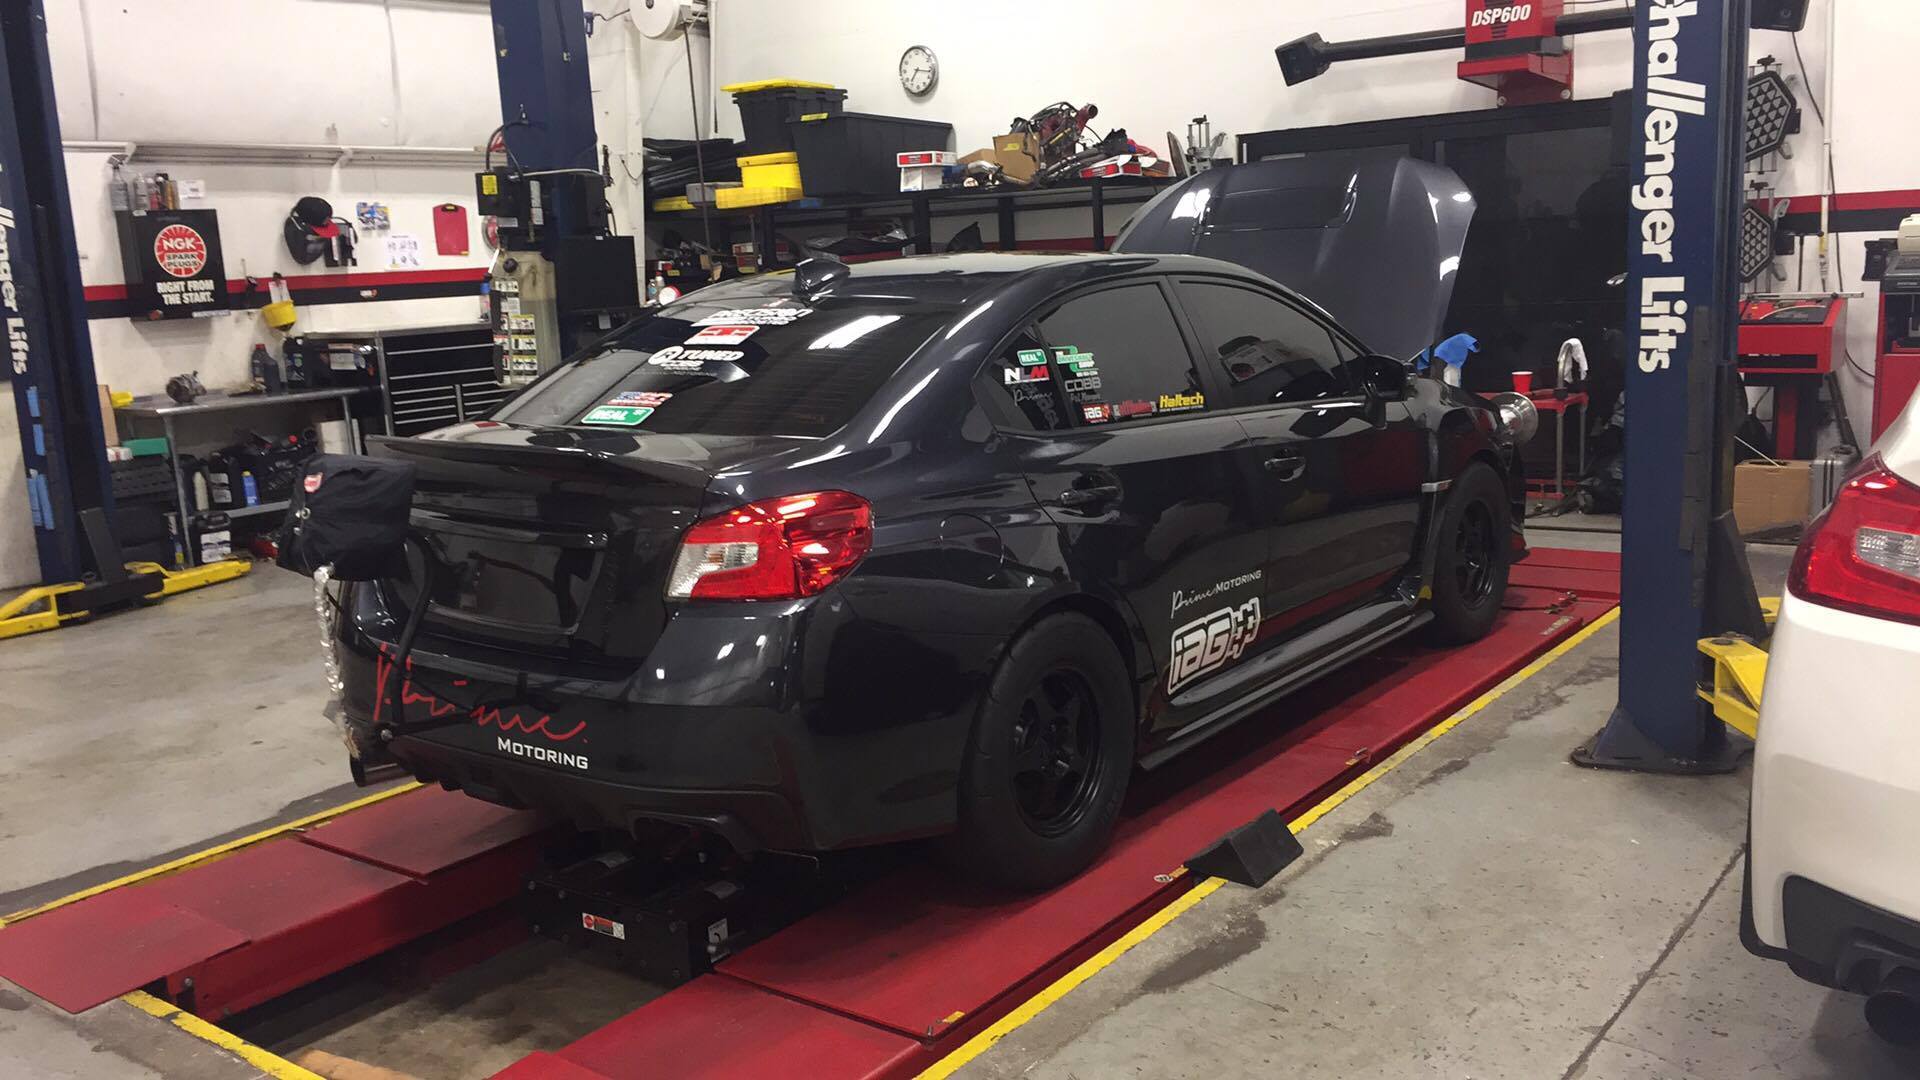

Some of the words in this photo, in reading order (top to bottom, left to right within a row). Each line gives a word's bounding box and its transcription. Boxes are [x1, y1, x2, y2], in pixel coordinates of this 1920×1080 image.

[1471, 4, 1531, 27] DSP600
[1632, 0, 1706, 262] hallenger
[162, 237, 197, 251] NGK
[156, 281, 186, 294] RIGHT
[187, 280, 215, 292] FROM
[162, 293, 182, 306] THE
[1638, 276, 1688, 373] Lifts
[6, 317, 30, 375] Lifts
[1065, 377, 1101, 392] COBB
[1160, 392, 1204, 408] Haltech
[1170, 590, 1215, 619] Prime
[1214, 569, 1262, 594] MOTORING
[497, 736, 589, 770] MOTORING
